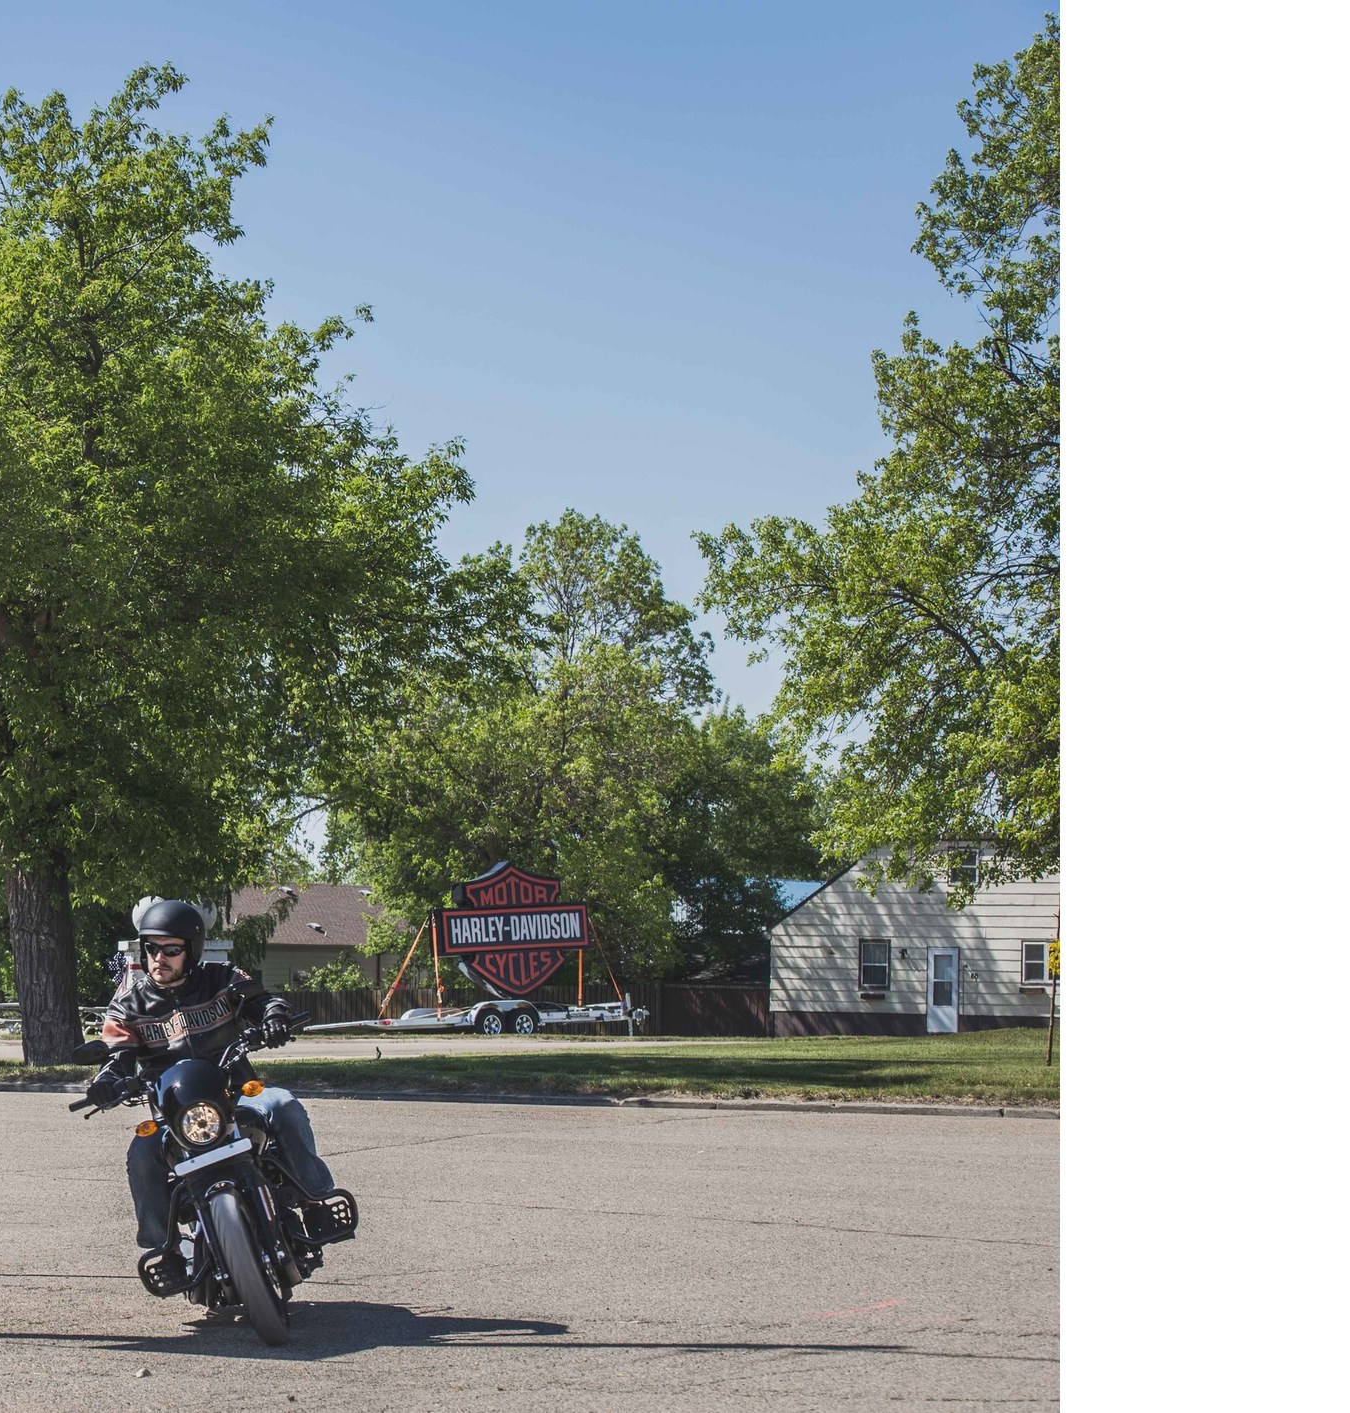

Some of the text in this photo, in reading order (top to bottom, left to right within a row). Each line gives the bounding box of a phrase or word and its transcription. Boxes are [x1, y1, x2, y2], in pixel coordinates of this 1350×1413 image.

[480, 876, 548, 907] MOTOR
[451, 912, 581, 944] HARLEY-DAVIDSON
[485, 951, 552, 986] CYCLES
[137, 996, 231, 1041] HARLEY-DAVIDSON
